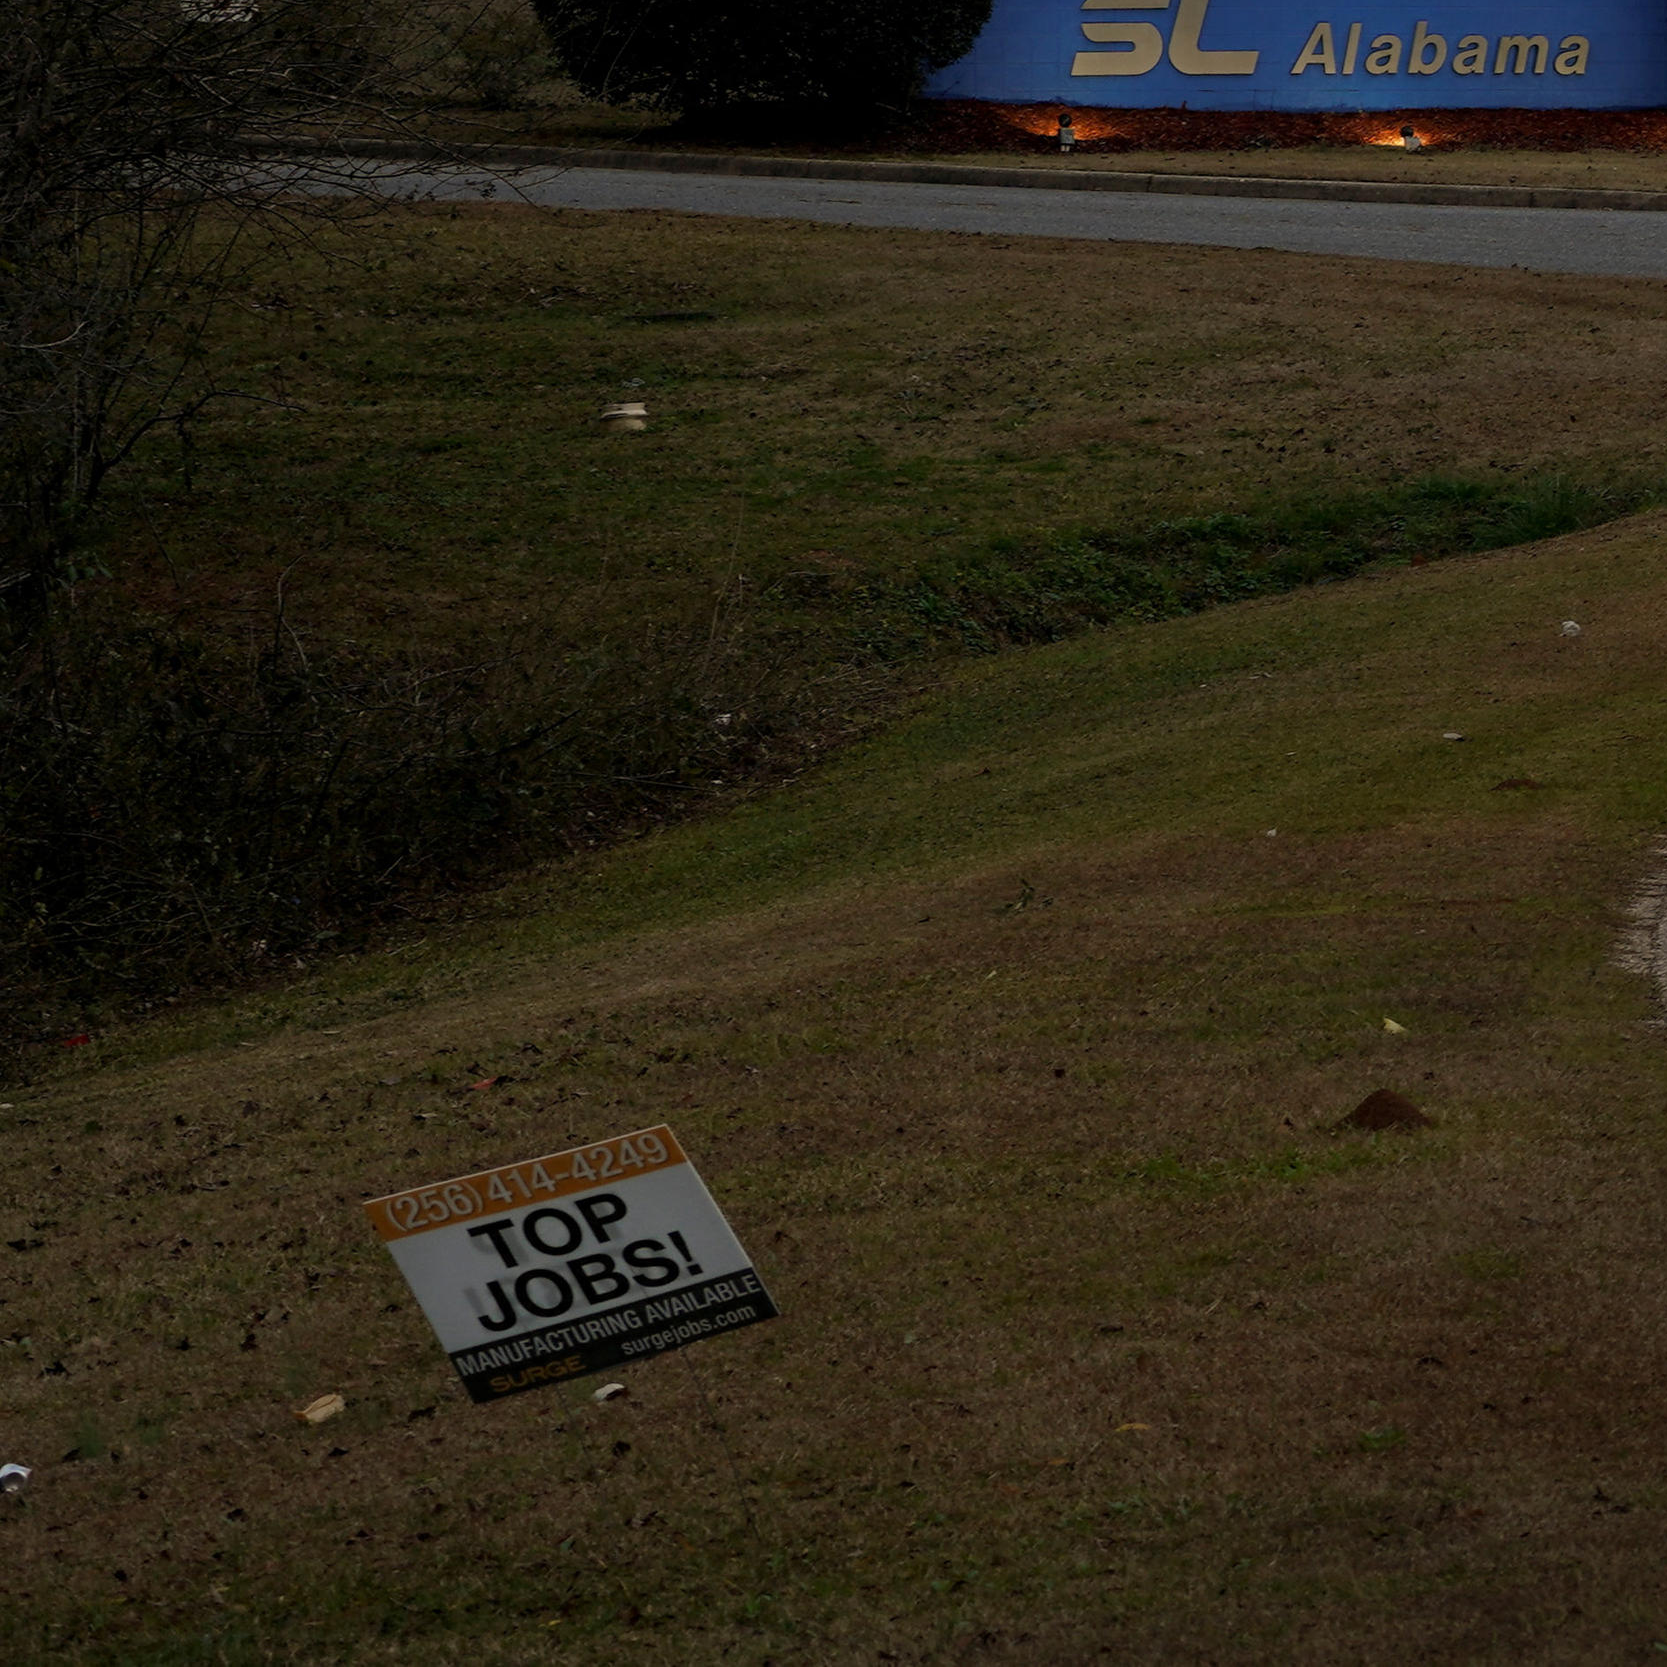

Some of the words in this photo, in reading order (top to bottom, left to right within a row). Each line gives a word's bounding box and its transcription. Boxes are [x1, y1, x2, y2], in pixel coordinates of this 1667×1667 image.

[1291, 20, 1591, 76] Alabama
[385, 1183, 484, 1231] (256)
[487, 1133, 669, 1206] 414-4249
[467, 1193, 627, 1268] TOP
[454, 1308, 640, 1377] MANUFACTURING
[645, 1275, 763, 1325] AVAILABLE
[478, 1231, 704, 1332] JOBS!
[490, 1354, 587, 1394] SURGE
[621, 1304, 757, 1357] surgejobs.com
